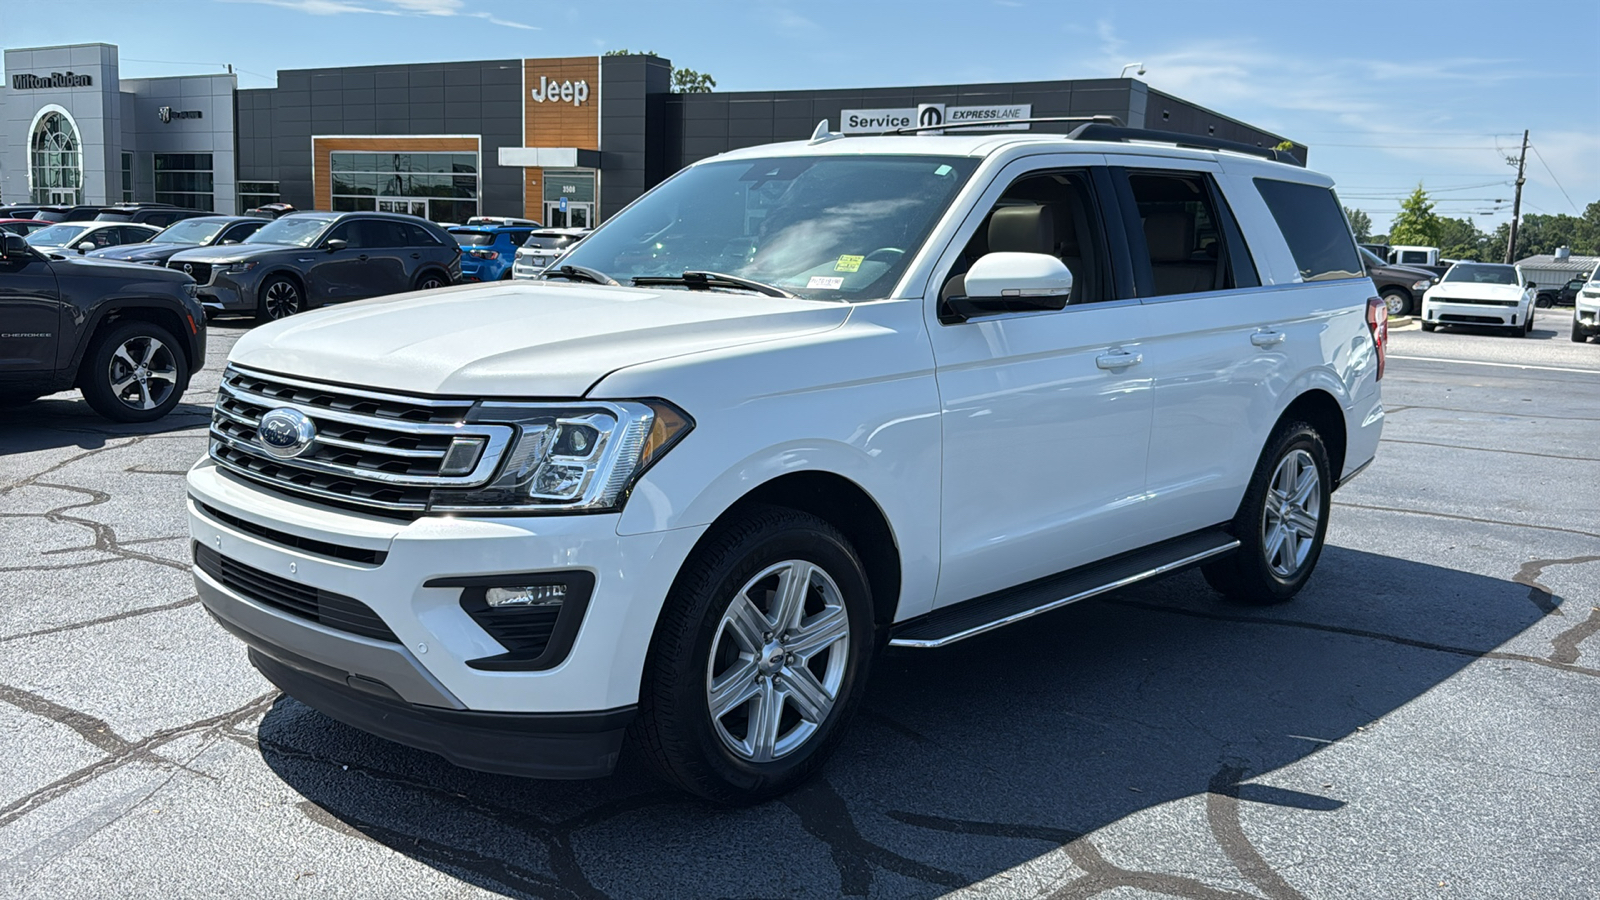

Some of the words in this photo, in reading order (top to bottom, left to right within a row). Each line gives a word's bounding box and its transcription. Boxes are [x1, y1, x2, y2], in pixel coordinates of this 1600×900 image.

[13, 74, 51, 89] Milton
[51, 72, 91, 88] Ruben
[531, 76, 589, 107] Jeep
[849, 115, 910, 128] Service
[952, 109, 1021, 119] EXPRESSLANE
[562, 185, 576, 193] 3508
[264, 420, 291, 444] Ford
